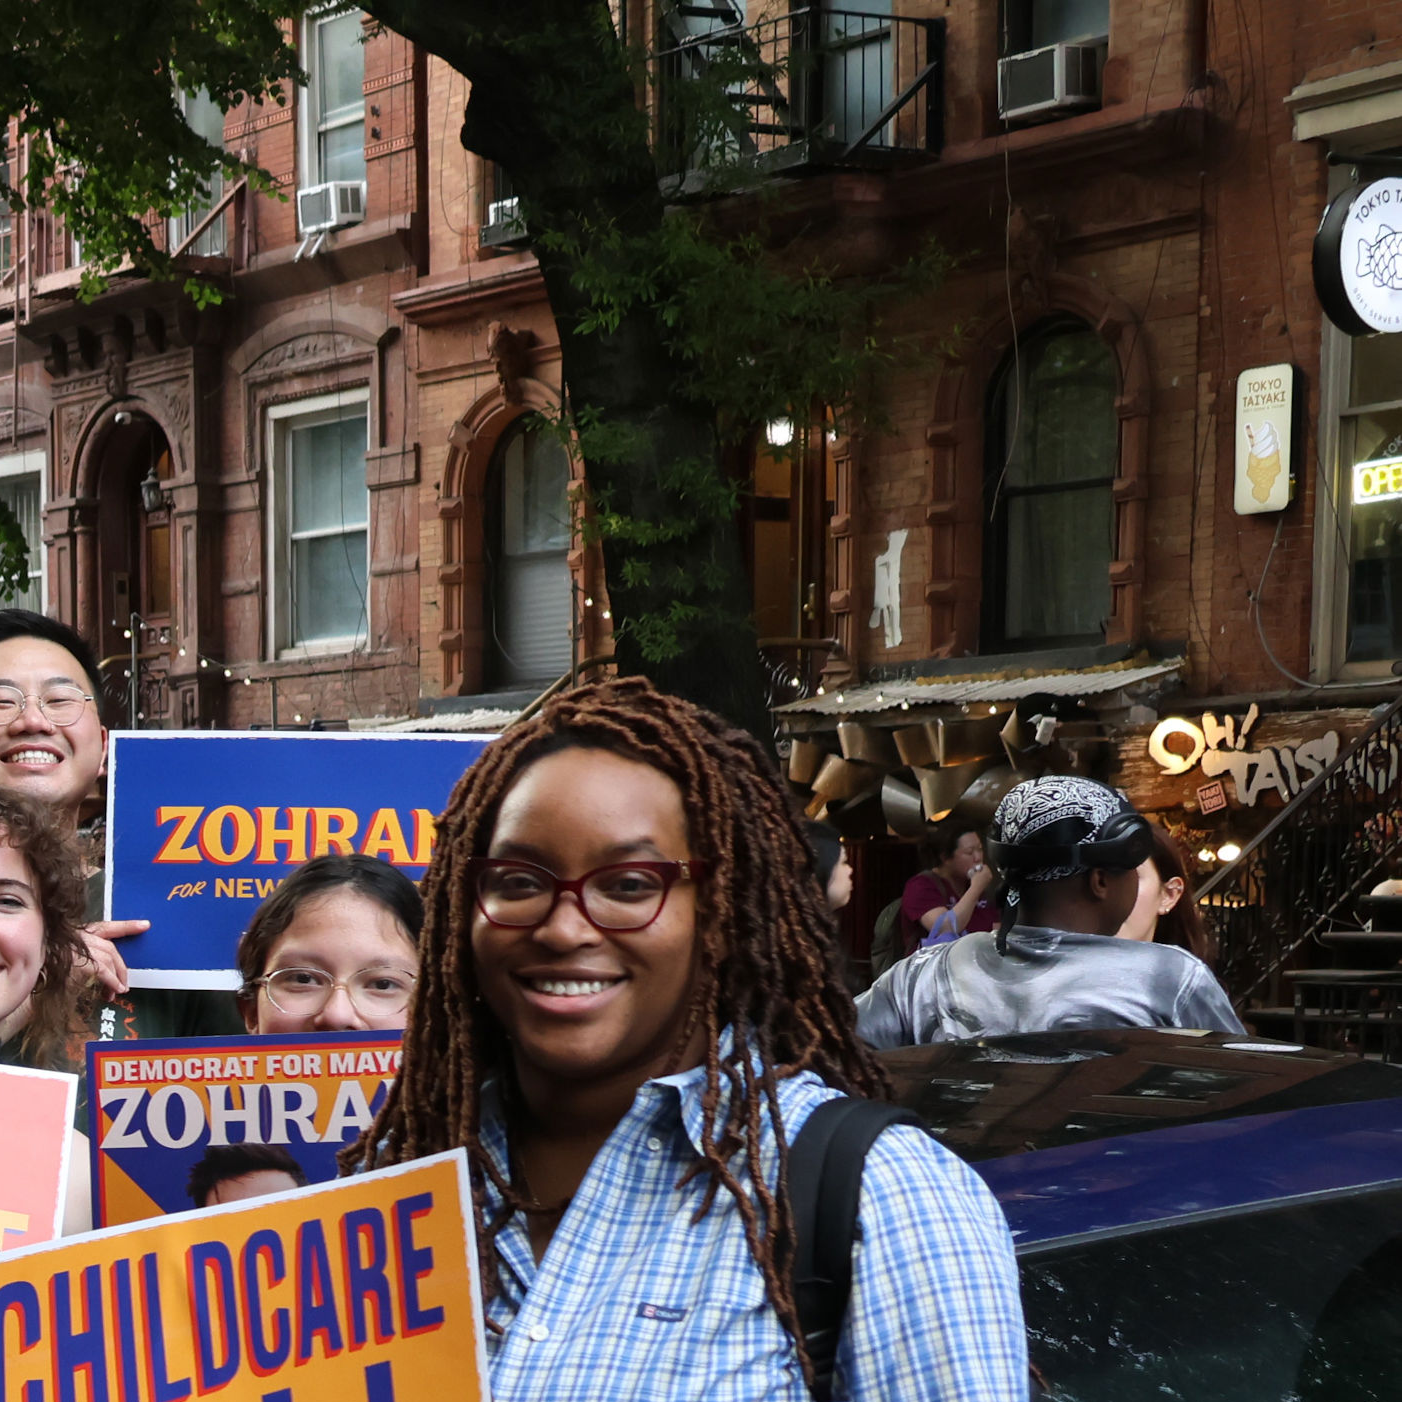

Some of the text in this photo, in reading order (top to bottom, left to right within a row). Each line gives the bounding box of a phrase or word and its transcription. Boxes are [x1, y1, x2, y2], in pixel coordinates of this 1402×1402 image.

[1355, 189, 1391, 224] TOKYO
[1243, 390, 1285, 408] TAIYAKI
[1248, 378, 1282, 393] TOKYO
[1360, 463, 1402, 497] OPE
[167, 878, 285, 900] FOR NEW
[104, 1050, 404, 1083] DEMOCRAT FOR MAY
[99, 1079, 396, 1149] ZOHRA
